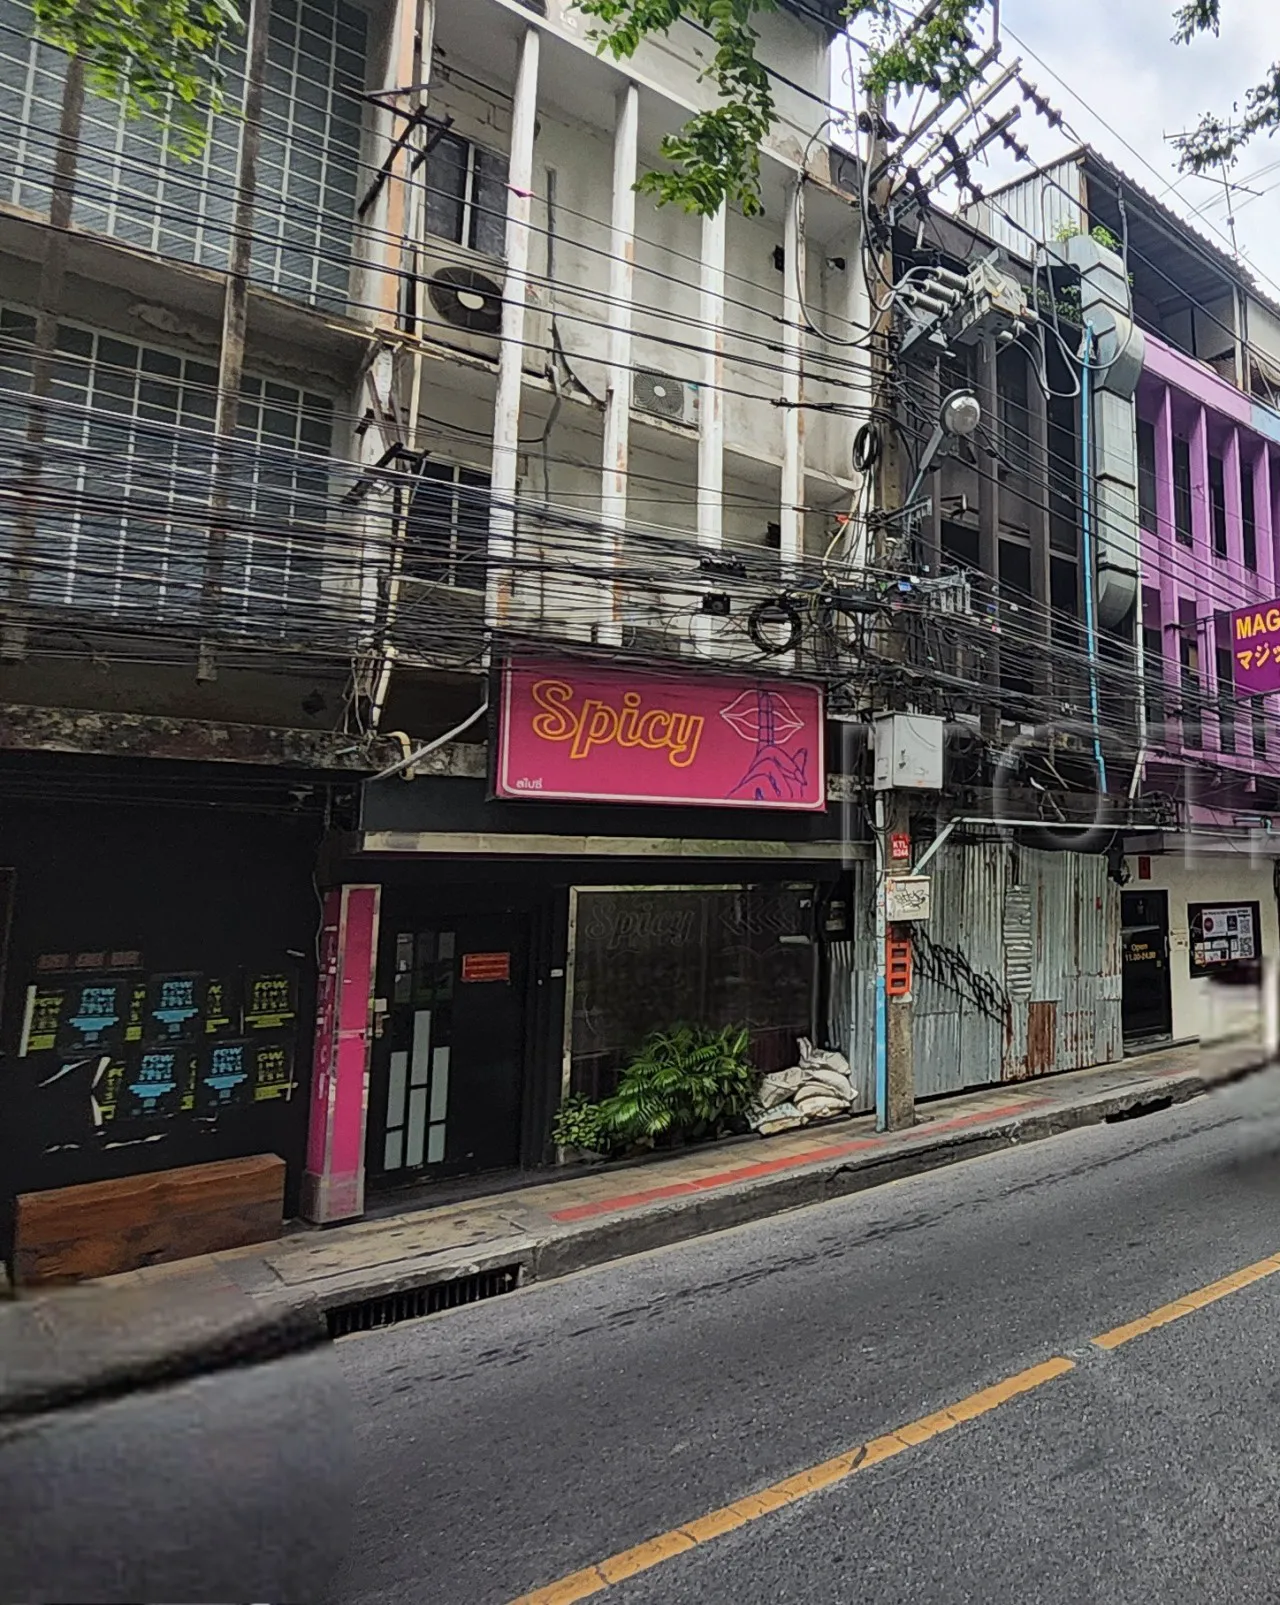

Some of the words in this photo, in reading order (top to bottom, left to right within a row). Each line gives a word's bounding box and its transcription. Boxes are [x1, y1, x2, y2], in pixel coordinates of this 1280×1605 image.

[531, 679, 704, 768] Spicy
[893, 840, 908, 849] KTL
[1131, 943, 1149, 952] Open
